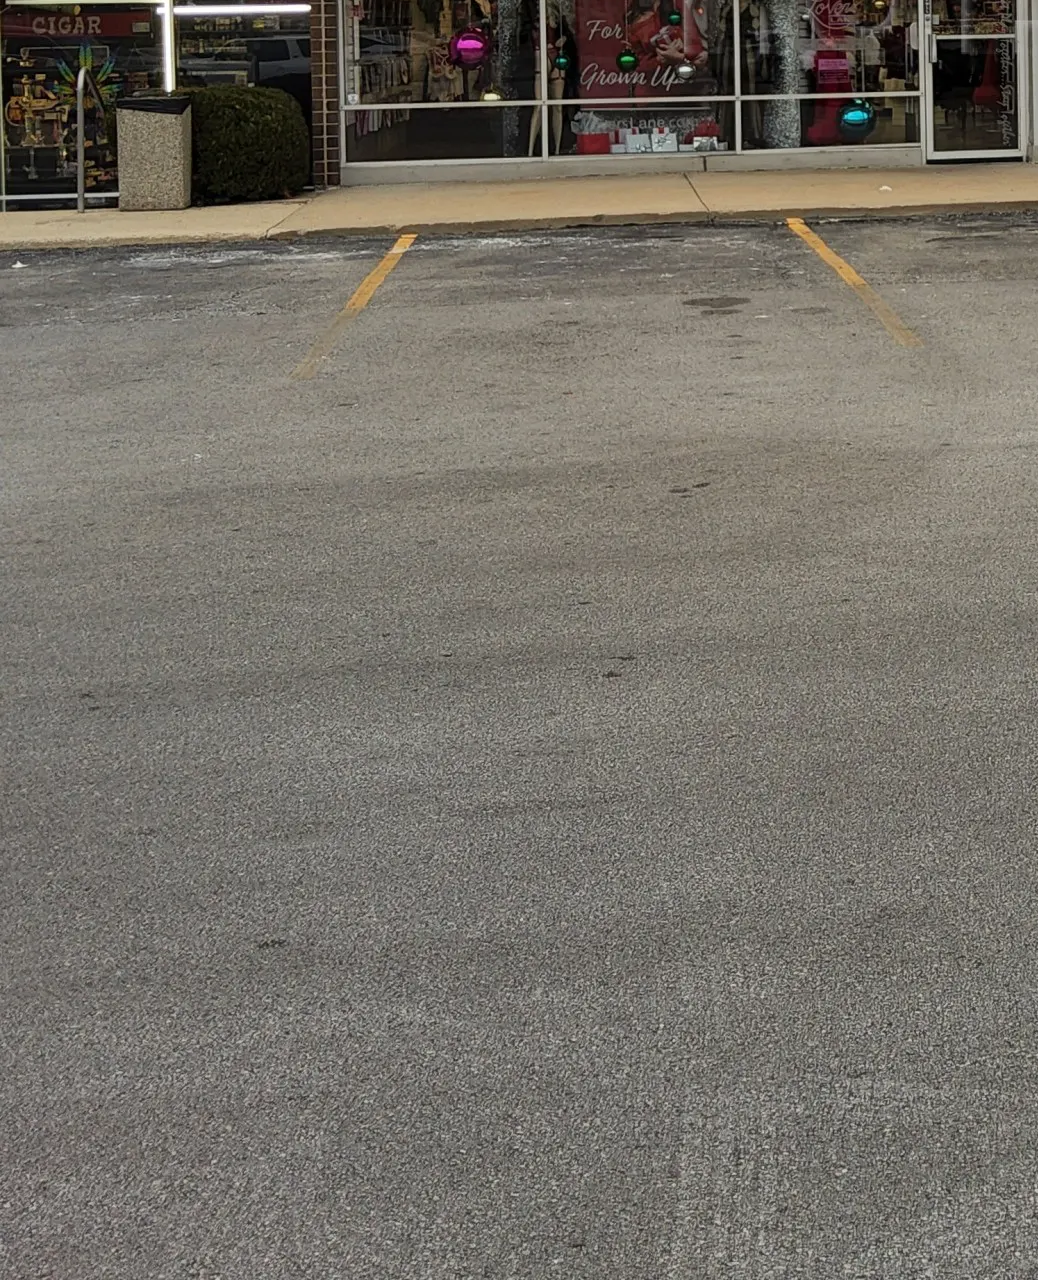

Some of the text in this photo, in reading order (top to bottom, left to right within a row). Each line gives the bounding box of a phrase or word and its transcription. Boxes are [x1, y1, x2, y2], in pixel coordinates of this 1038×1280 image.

[32, 16, 102, 35] CIGAR
[586, 20, 624, 41] For
[580, 62, 647, 91] Grown
